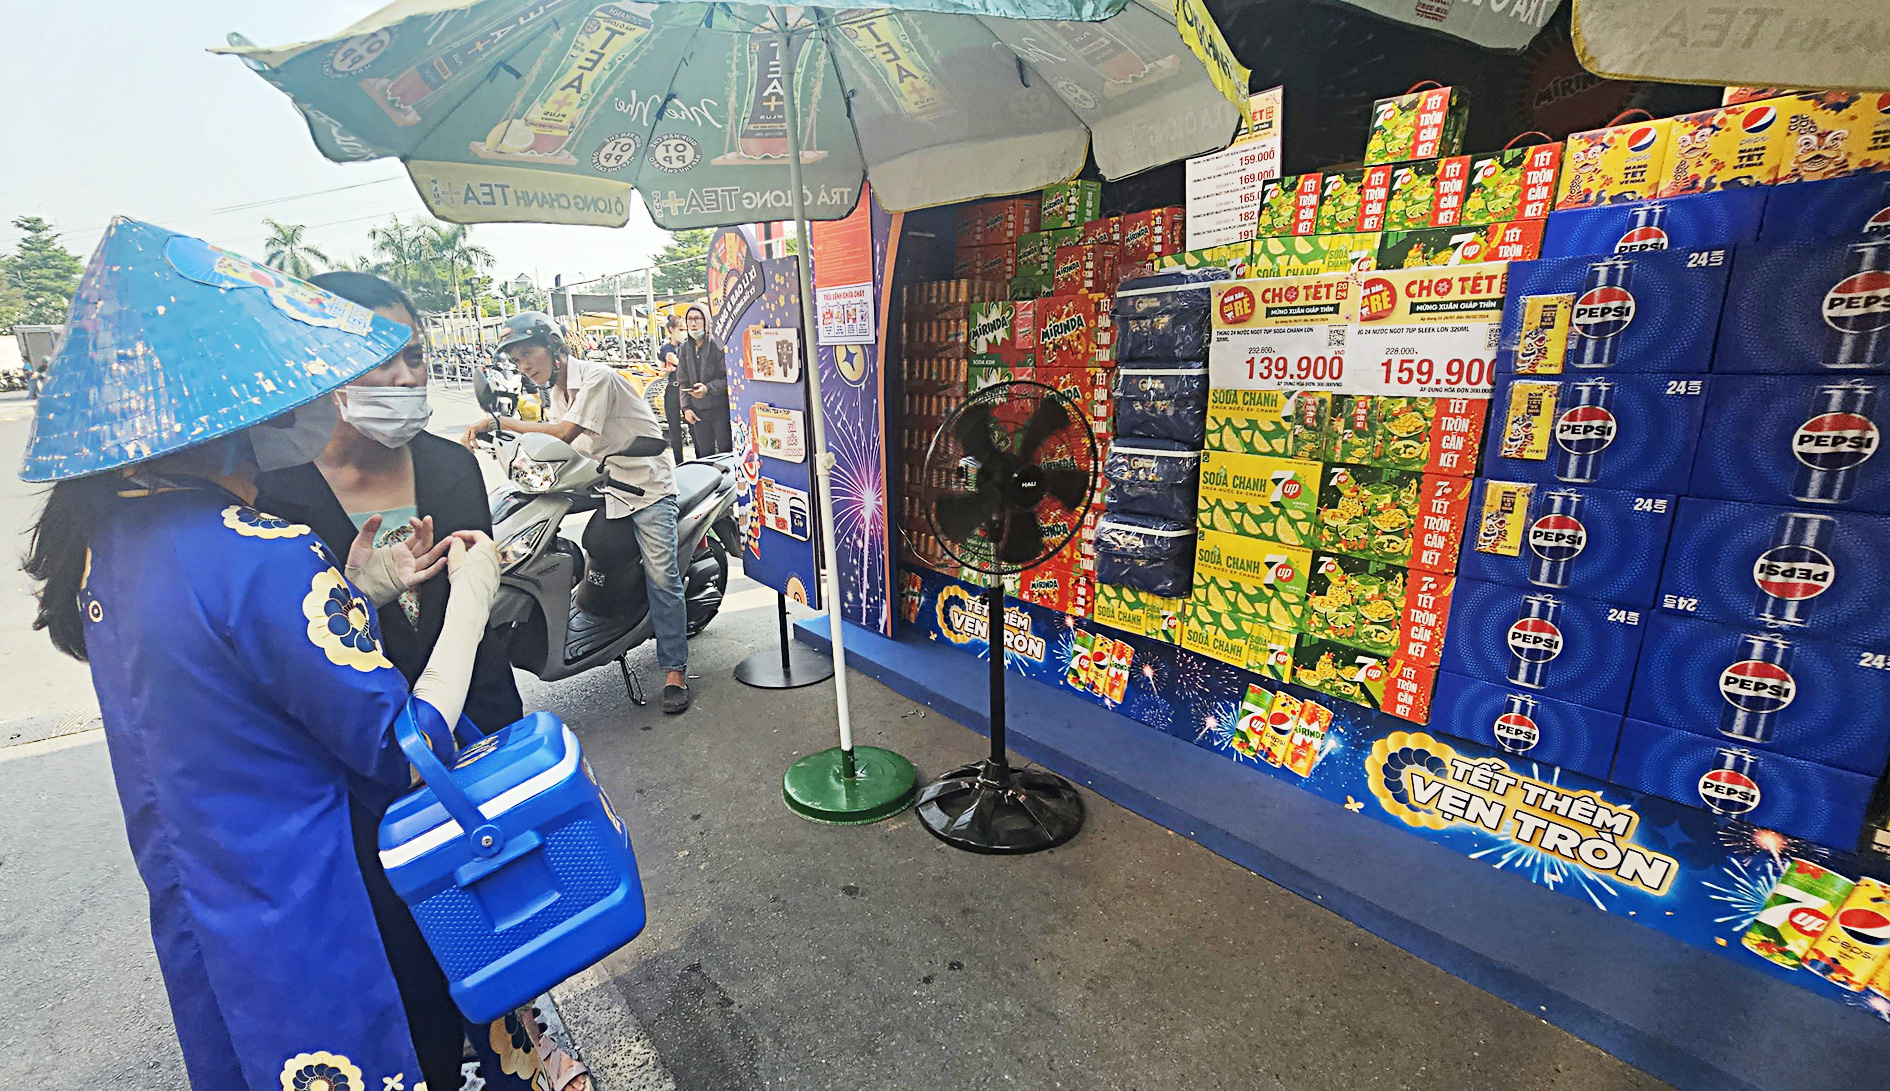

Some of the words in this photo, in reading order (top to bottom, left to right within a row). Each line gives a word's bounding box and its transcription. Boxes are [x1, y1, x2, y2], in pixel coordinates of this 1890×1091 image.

[1426, 95, 1443, 111] TẾT
[1239, 149, 1275, 166] 159.000
[1416, 141, 1435, 157] KẾT
[1533, 150, 1553, 167] TẾT
[1239, 168, 1275, 185] 169.000
[1445, 162, 1462, 178] TẾT
[1239, 190, 1262, 204] 165.0
[1438, 208, 1455, 225] KẾT
[1525, 199, 1546, 218] KẾT
[1505, 228, 1522, 242] TẾT
[1687, 252, 1708, 268] 24
[1261, 286, 1299, 304] CHỢ
[1303, 281, 1334, 301] TẾT
[1405, 277, 1453, 299] CHỢ
[1458, 271, 1498, 295] TẾT
[1288, 306, 1304, 314] XUÂN
[1306, 305, 1319, 313] GIÁP
[1416, 303, 1439, 311] MỪNG
[1439, 302, 1459, 310] XUÂN
[1460, 301, 1479, 309] GIÁP
[1480, 300, 1496, 308] THÌN
[1576, 305, 1630, 319] PEPSI
[1245, 356, 1343, 380] 139.900
[1666, 380, 1686, 394] 24
[1212, 389, 1238, 405] SODA
[1243, 391, 1279, 407] CHANH
[1449, 399, 1468, 414] TẾT
[1559, 423, 1612, 437] PEPSI
[1798, 433, 1874, 449] PEPSI
[1439, 451, 1460, 468] KẾT
[1202, 470, 1228, 487] SODA
[1232, 475, 1267, 492] CHANH
[1431, 498, 1450, 515] TẾT
[1634, 497, 1653, 511] 24
[1532, 530, 1582, 546] PEPSI
[1198, 548, 1222, 566] SODA
[1226, 555, 1261, 575] CHANH
[1421, 549, 1442, 566] KẾT
[1758, 563, 1830, 583] PEPSI
[1418, 592, 1436, 609] TẾT
[1677, 597, 1698, 612] 24
[1003, 605, 1031, 631] HÊM
[1097, 604, 1119, 620] SODA
[1118, 610, 1142, 626] CHANH
[1608, 609, 1626, 622] 24
[952, 611, 988, 639] VẸN
[1004, 628, 1045, 661] RÒN
[1187, 629, 1210, 646] SODA
[1212, 638, 1243, 658] CHANH
[1512, 631, 1560, 650] PEPSI
[1408, 641, 1428, 658] KẾT
[1858, 651, 1884, 670] 24
[1402, 666, 1417, 680] TẾT
[1724, 675, 1790, 699] PEPSI
[1395, 703, 1411, 717] KẾT
[1497, 723, 1537, 741] PEPSI
[1451, 757, 1516, 796] TẾT
[1521, 783, 1634, 838] THÊM
[1702, 780, 1756, 804] PEPSI
[1410, 772, 1506, 831] VẸN
[1513, 809, 1672, 892] TRÒN
[1827, 935, 1877, 962] pepsi
